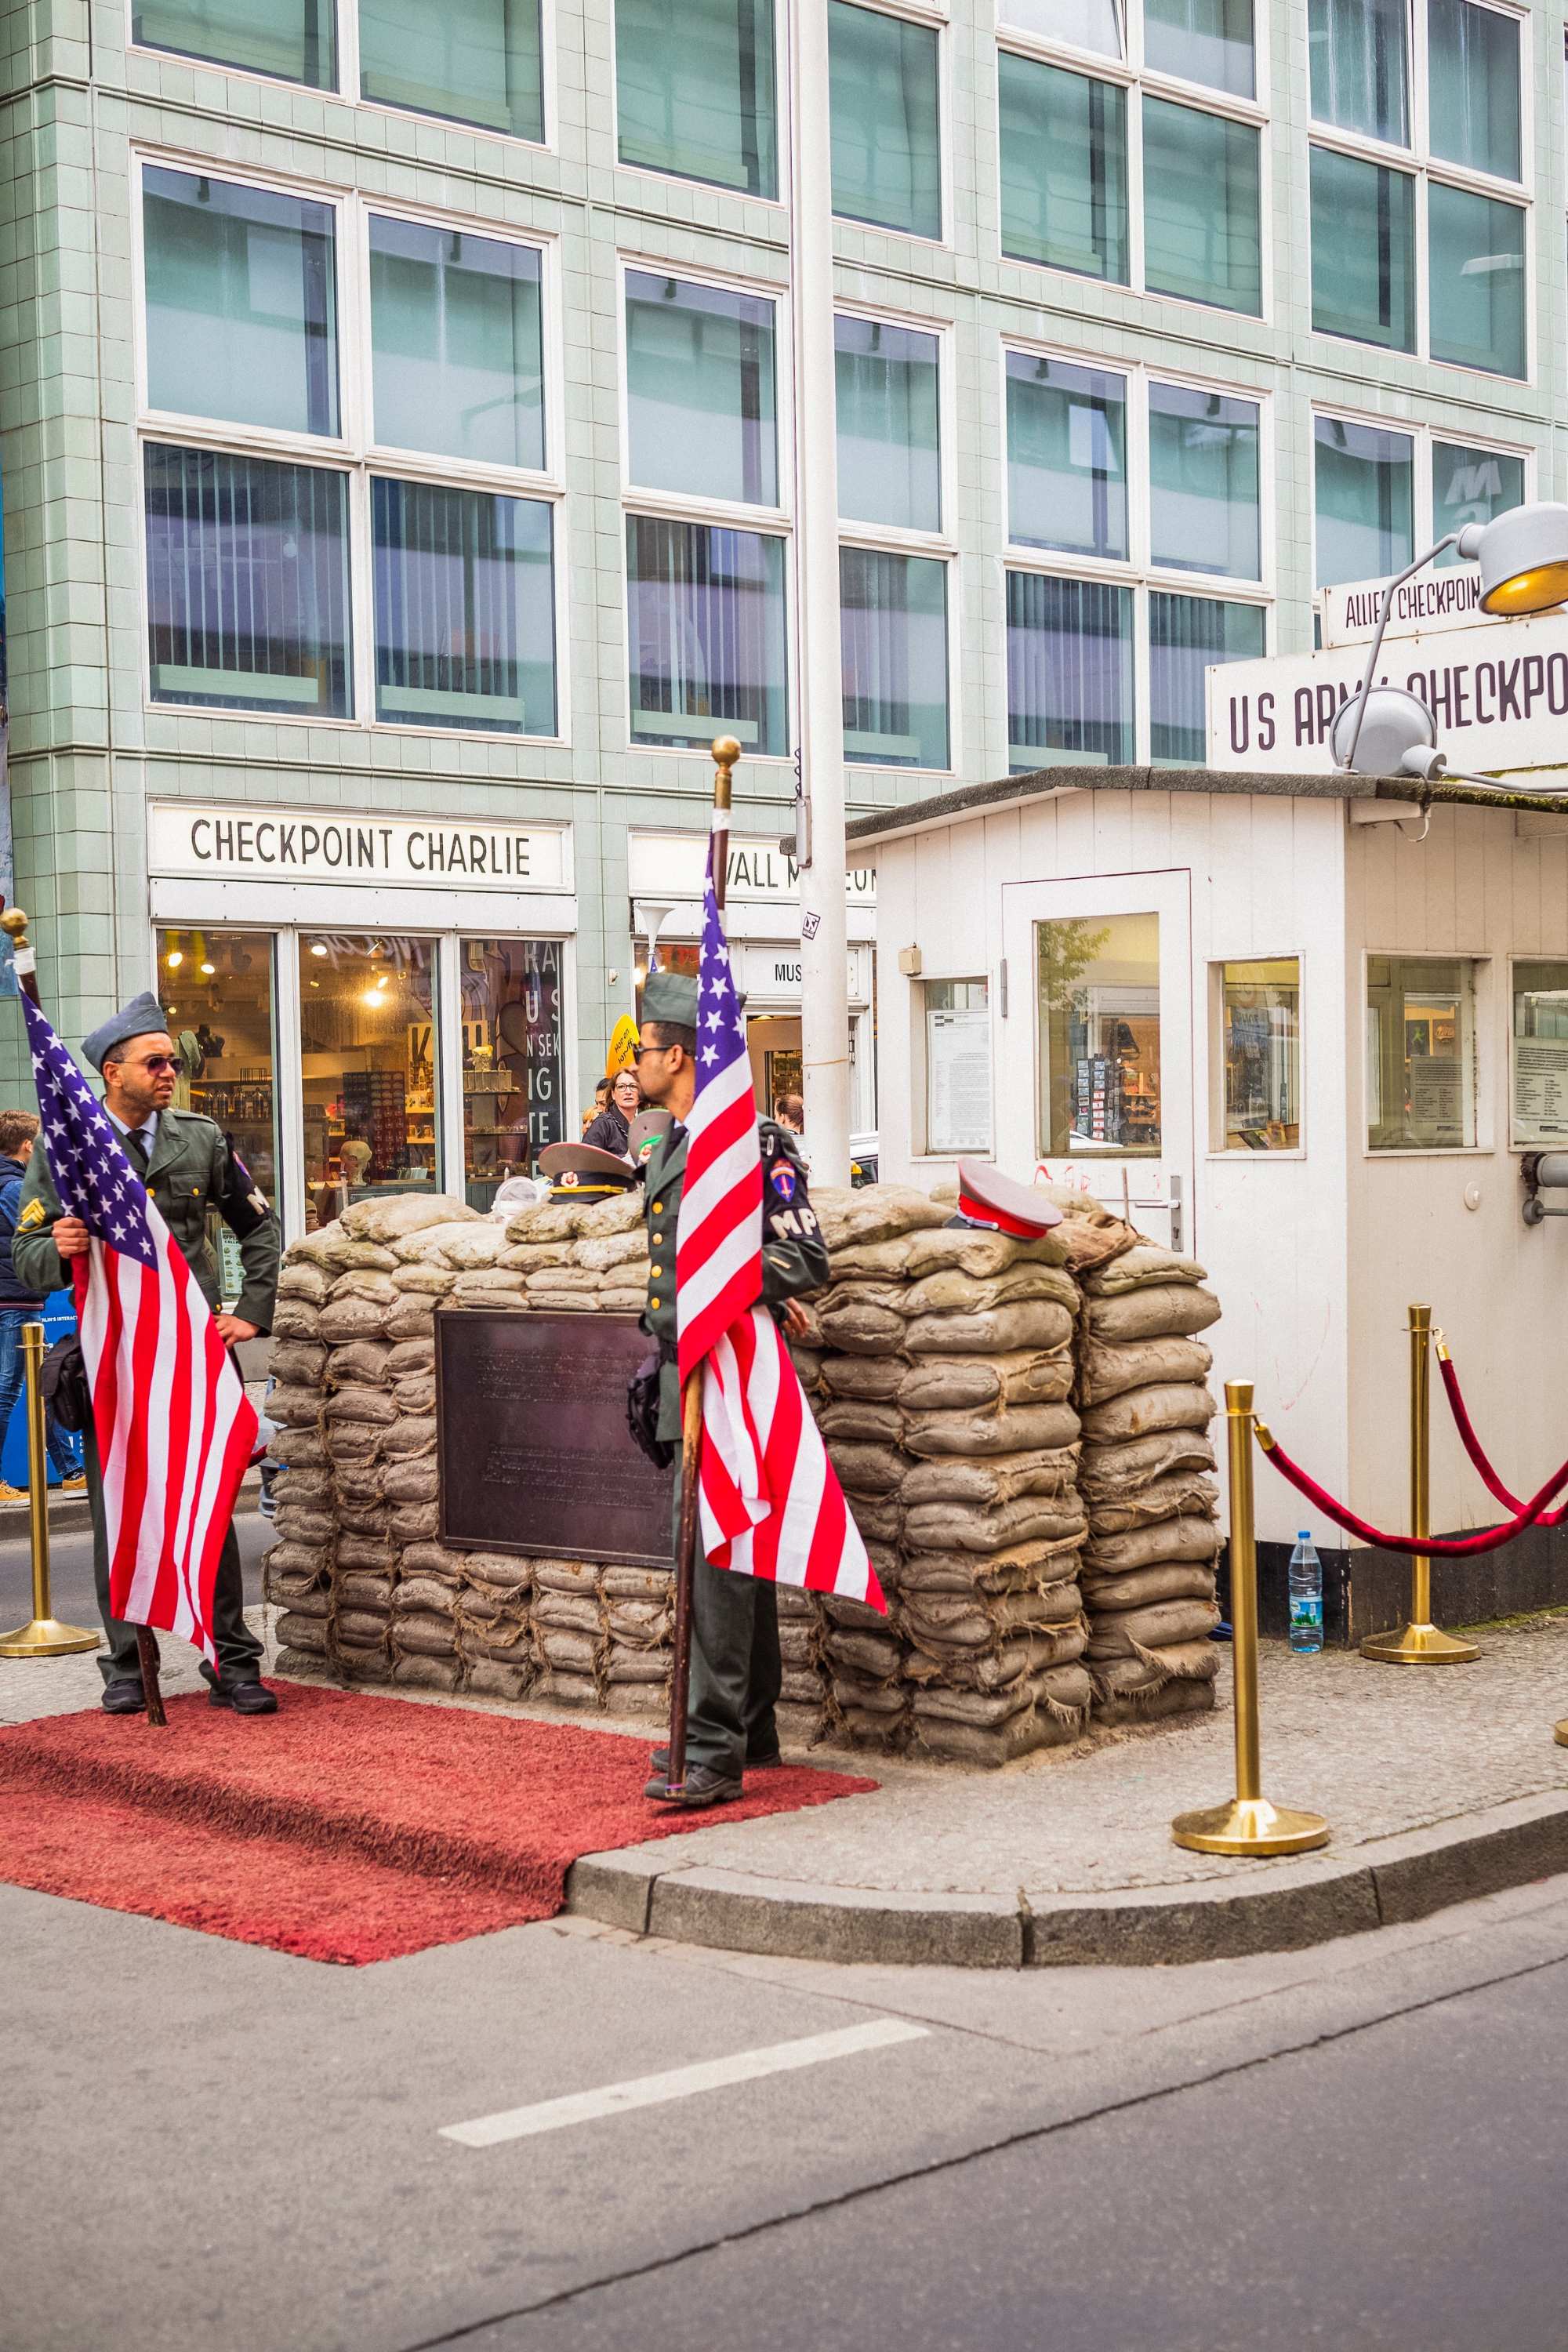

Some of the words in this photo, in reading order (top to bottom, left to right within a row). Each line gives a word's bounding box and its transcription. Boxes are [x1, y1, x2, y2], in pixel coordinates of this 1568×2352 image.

[1294, 676, 1388, 747] AR
[191, 818, 393, 869] CHECKPOINT
[407, 831, 530, 876] CHARLIE
[769, 1207, 817, 1240] MP
